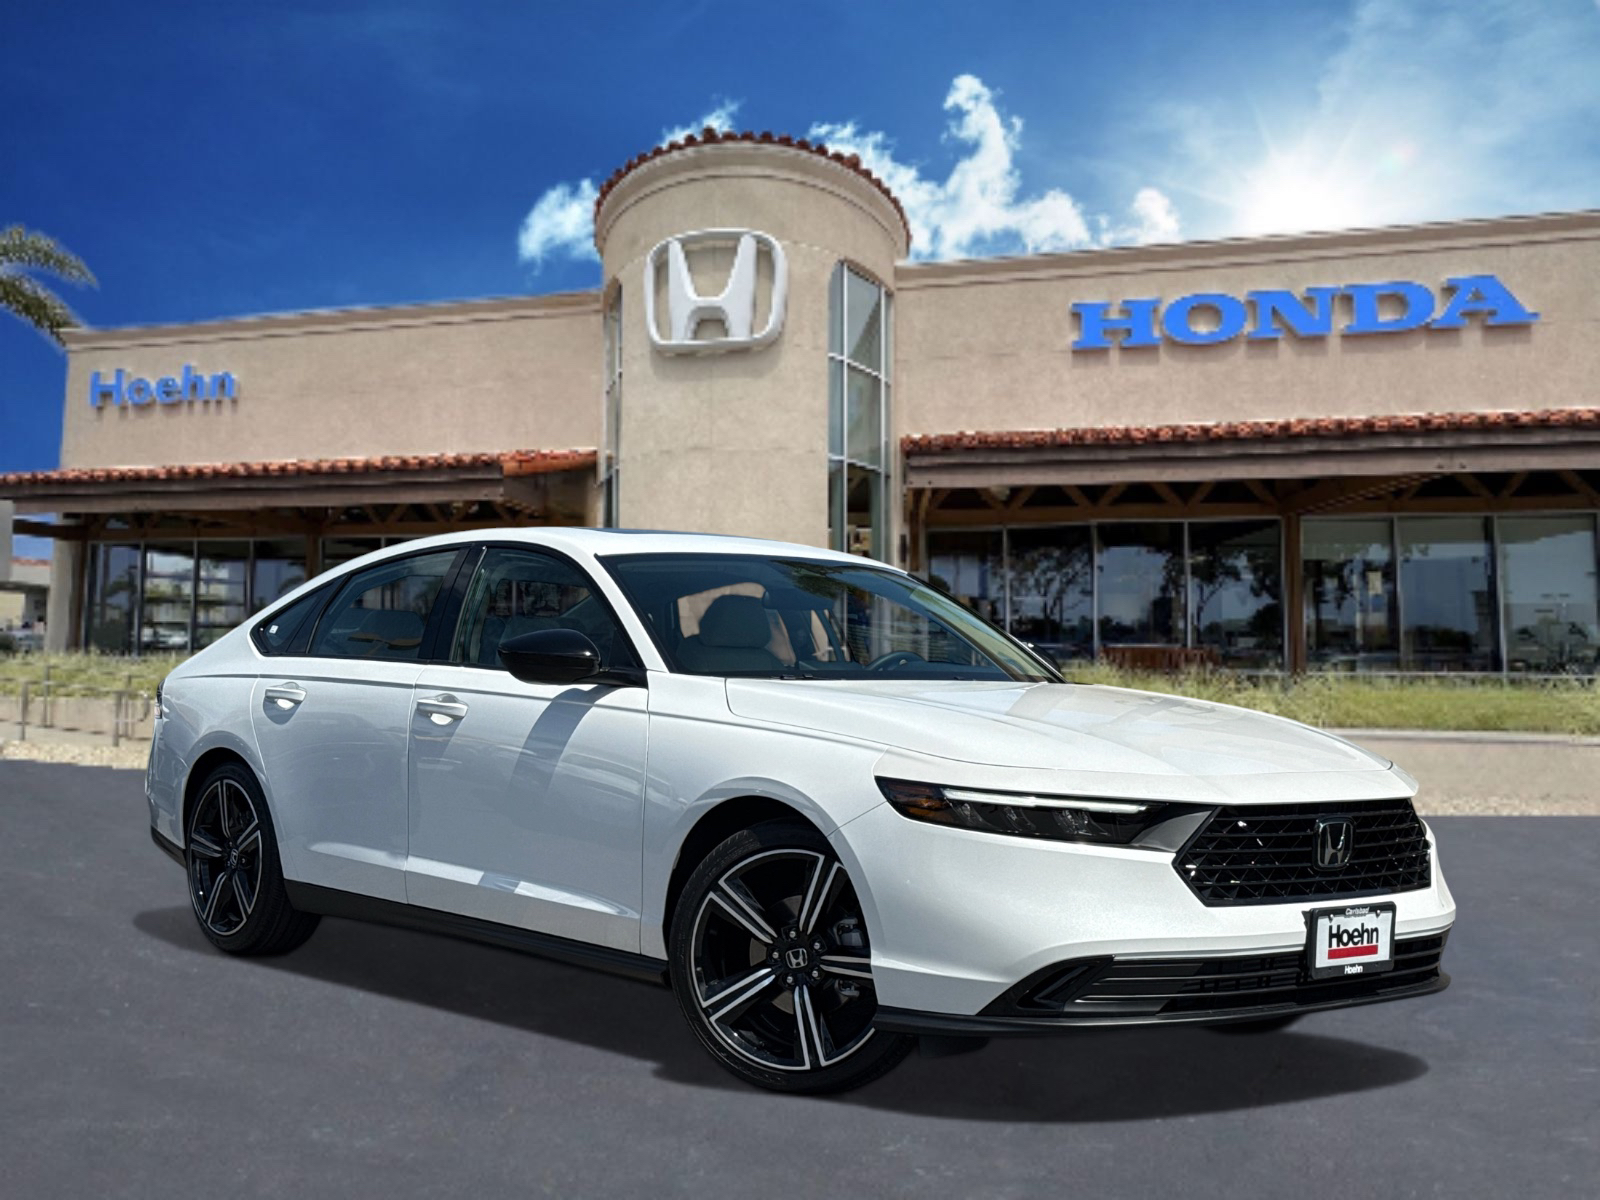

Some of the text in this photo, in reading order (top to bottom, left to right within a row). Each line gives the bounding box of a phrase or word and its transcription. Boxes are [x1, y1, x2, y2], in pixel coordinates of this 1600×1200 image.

[1071, 274, 1541, 350] HONDA
[90, 363, 236, 407] Hoehn
[1328, 922, 1379, 949] Hoehn
[1344, 963, 1363, 975] Hoehn
